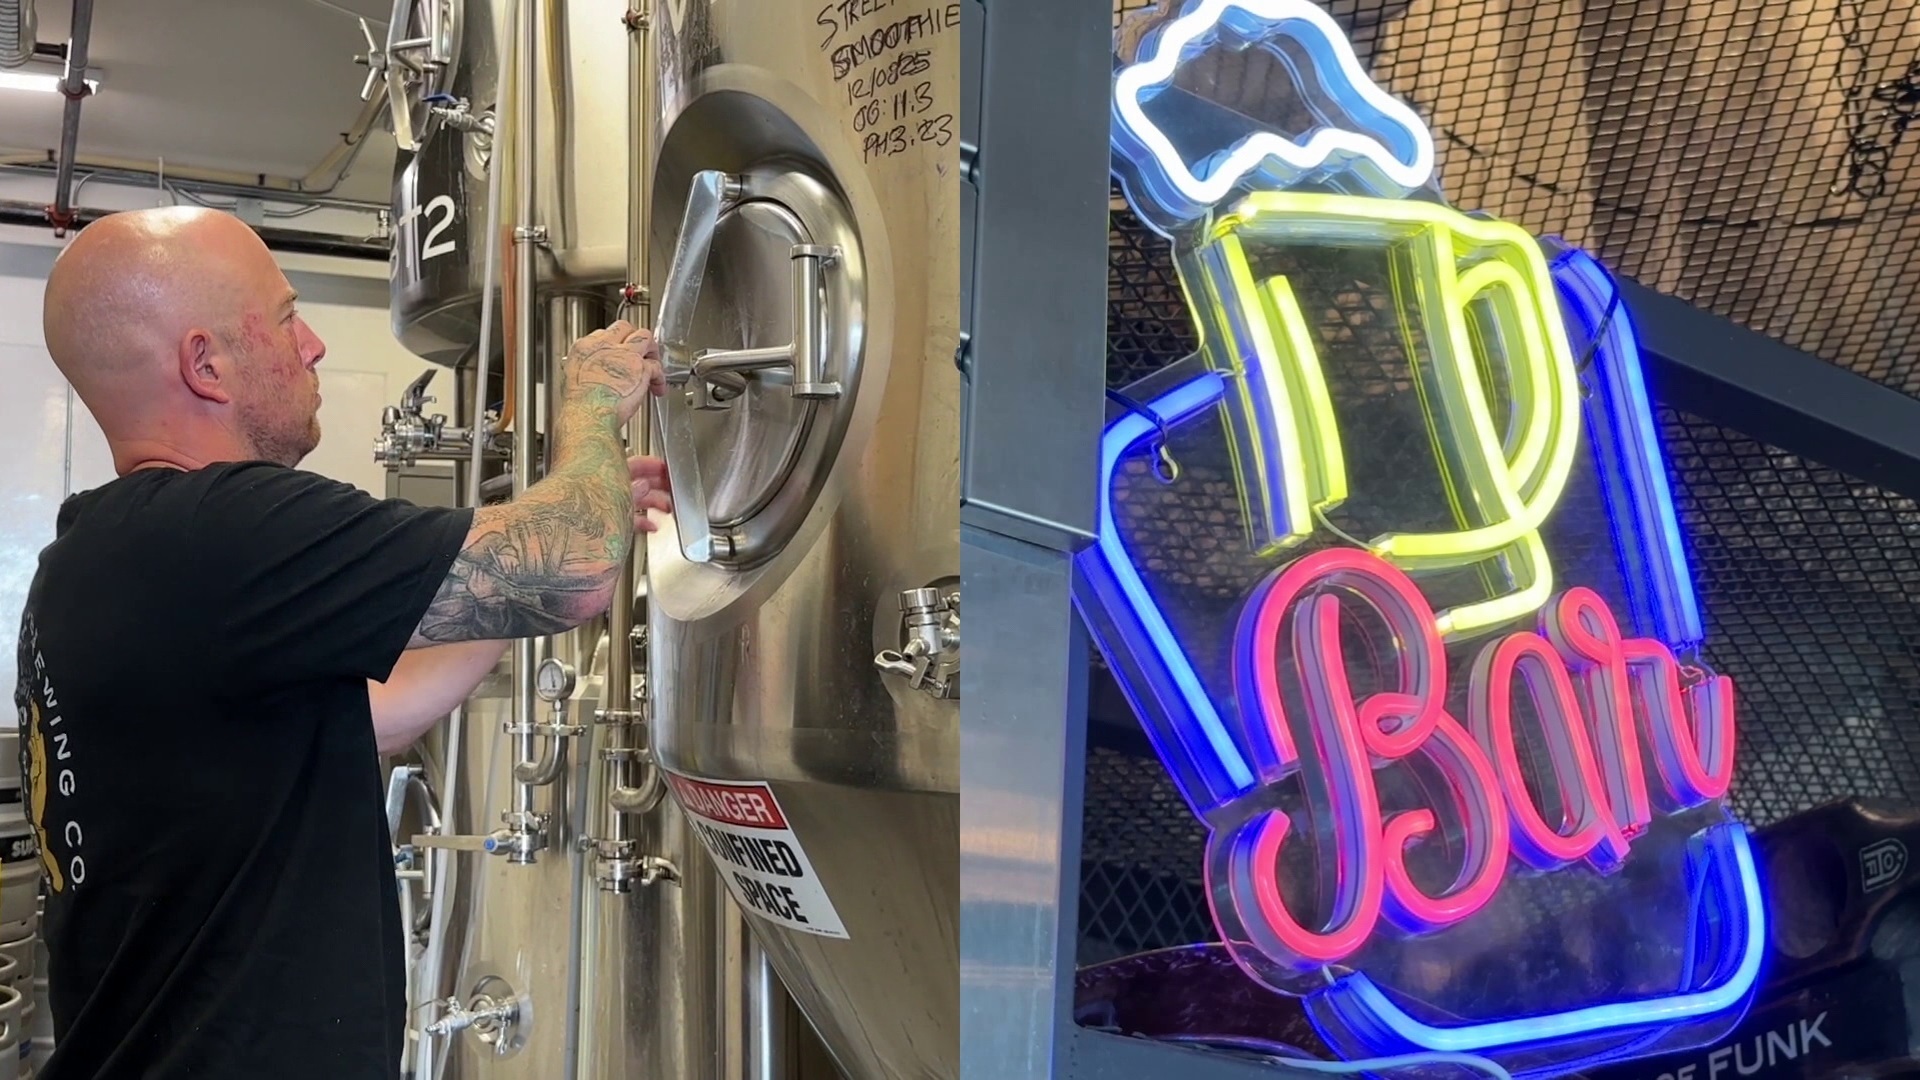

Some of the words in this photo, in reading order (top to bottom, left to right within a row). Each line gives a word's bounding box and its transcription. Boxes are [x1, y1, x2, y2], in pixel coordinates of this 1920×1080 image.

[817, 0, 894, 50] STRE
[26, 612, 76, 796] EWING
[1240, 547, 1735, 960] Bar
[686, 783, 775, 823] DANGER
[697, 820, 804, 878] CONFINED
[732, 871, 809, 924] SPACE
[1708, 1011, 1833, 1080] FUNK
